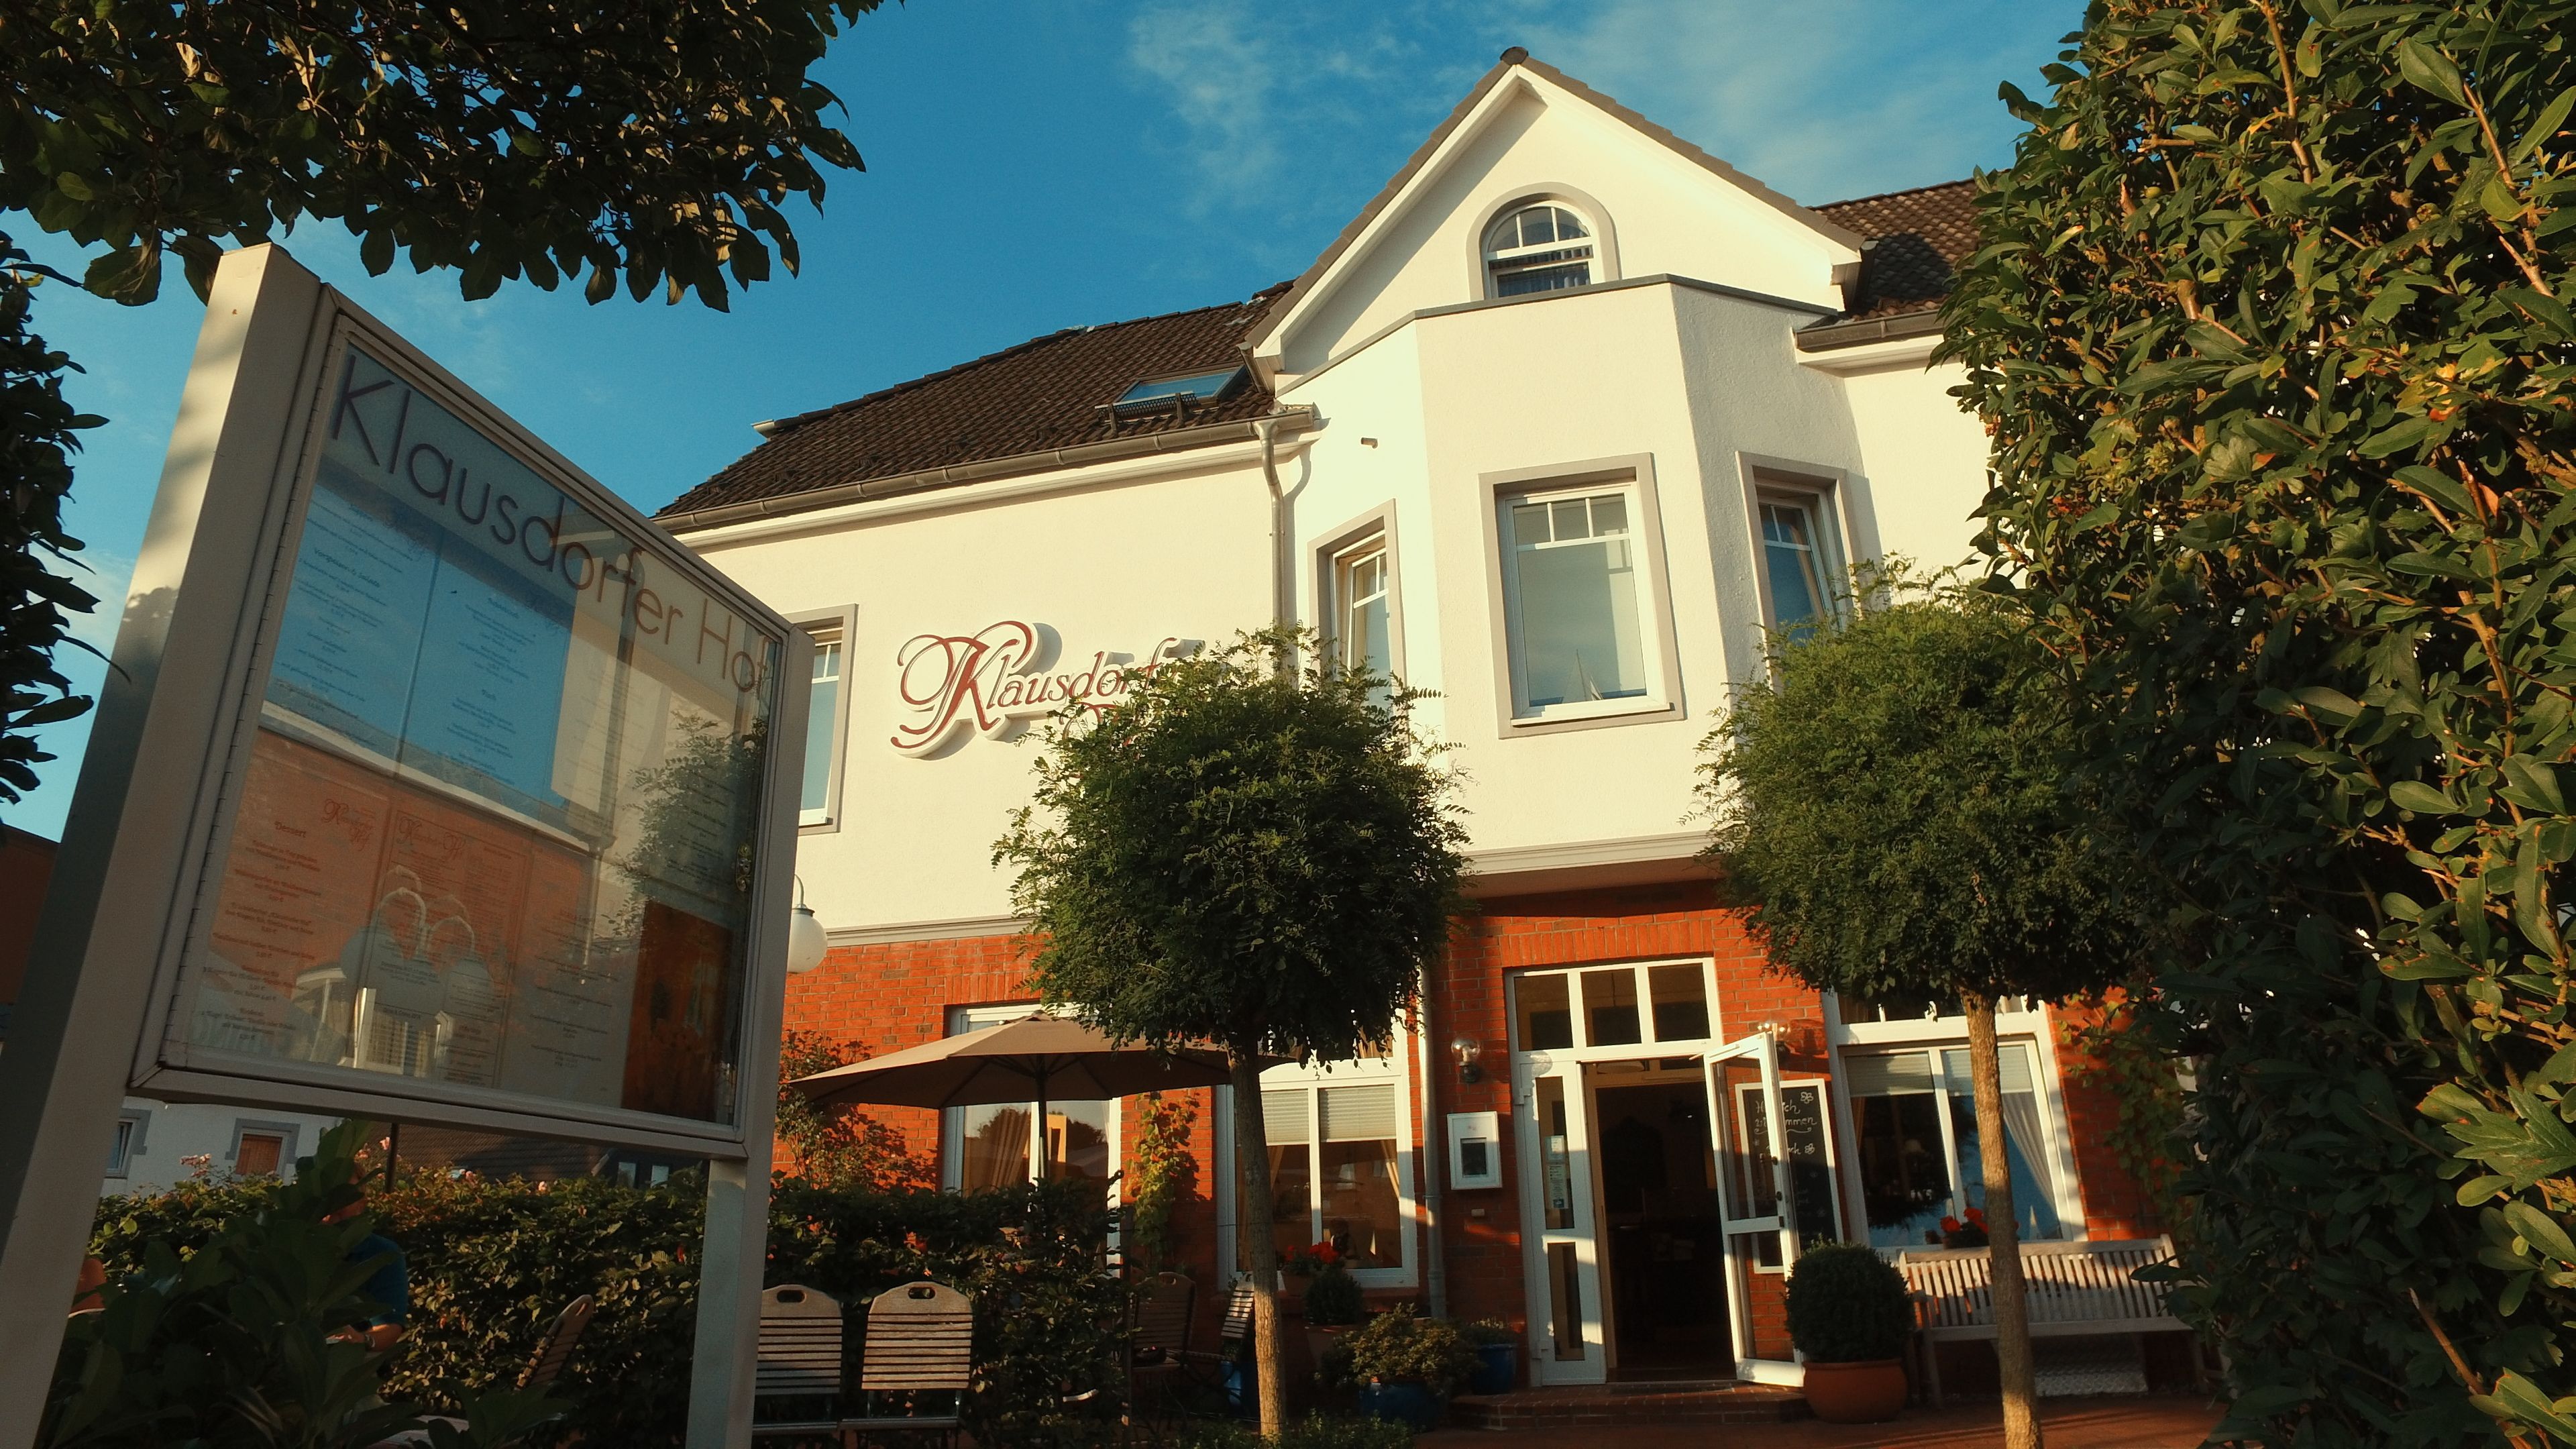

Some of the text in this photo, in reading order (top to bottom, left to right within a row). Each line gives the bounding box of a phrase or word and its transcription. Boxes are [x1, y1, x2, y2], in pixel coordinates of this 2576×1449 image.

[332, 354, 773, 700] Klausdorfer Hof
[274, 820, 307, 839] Dessert
